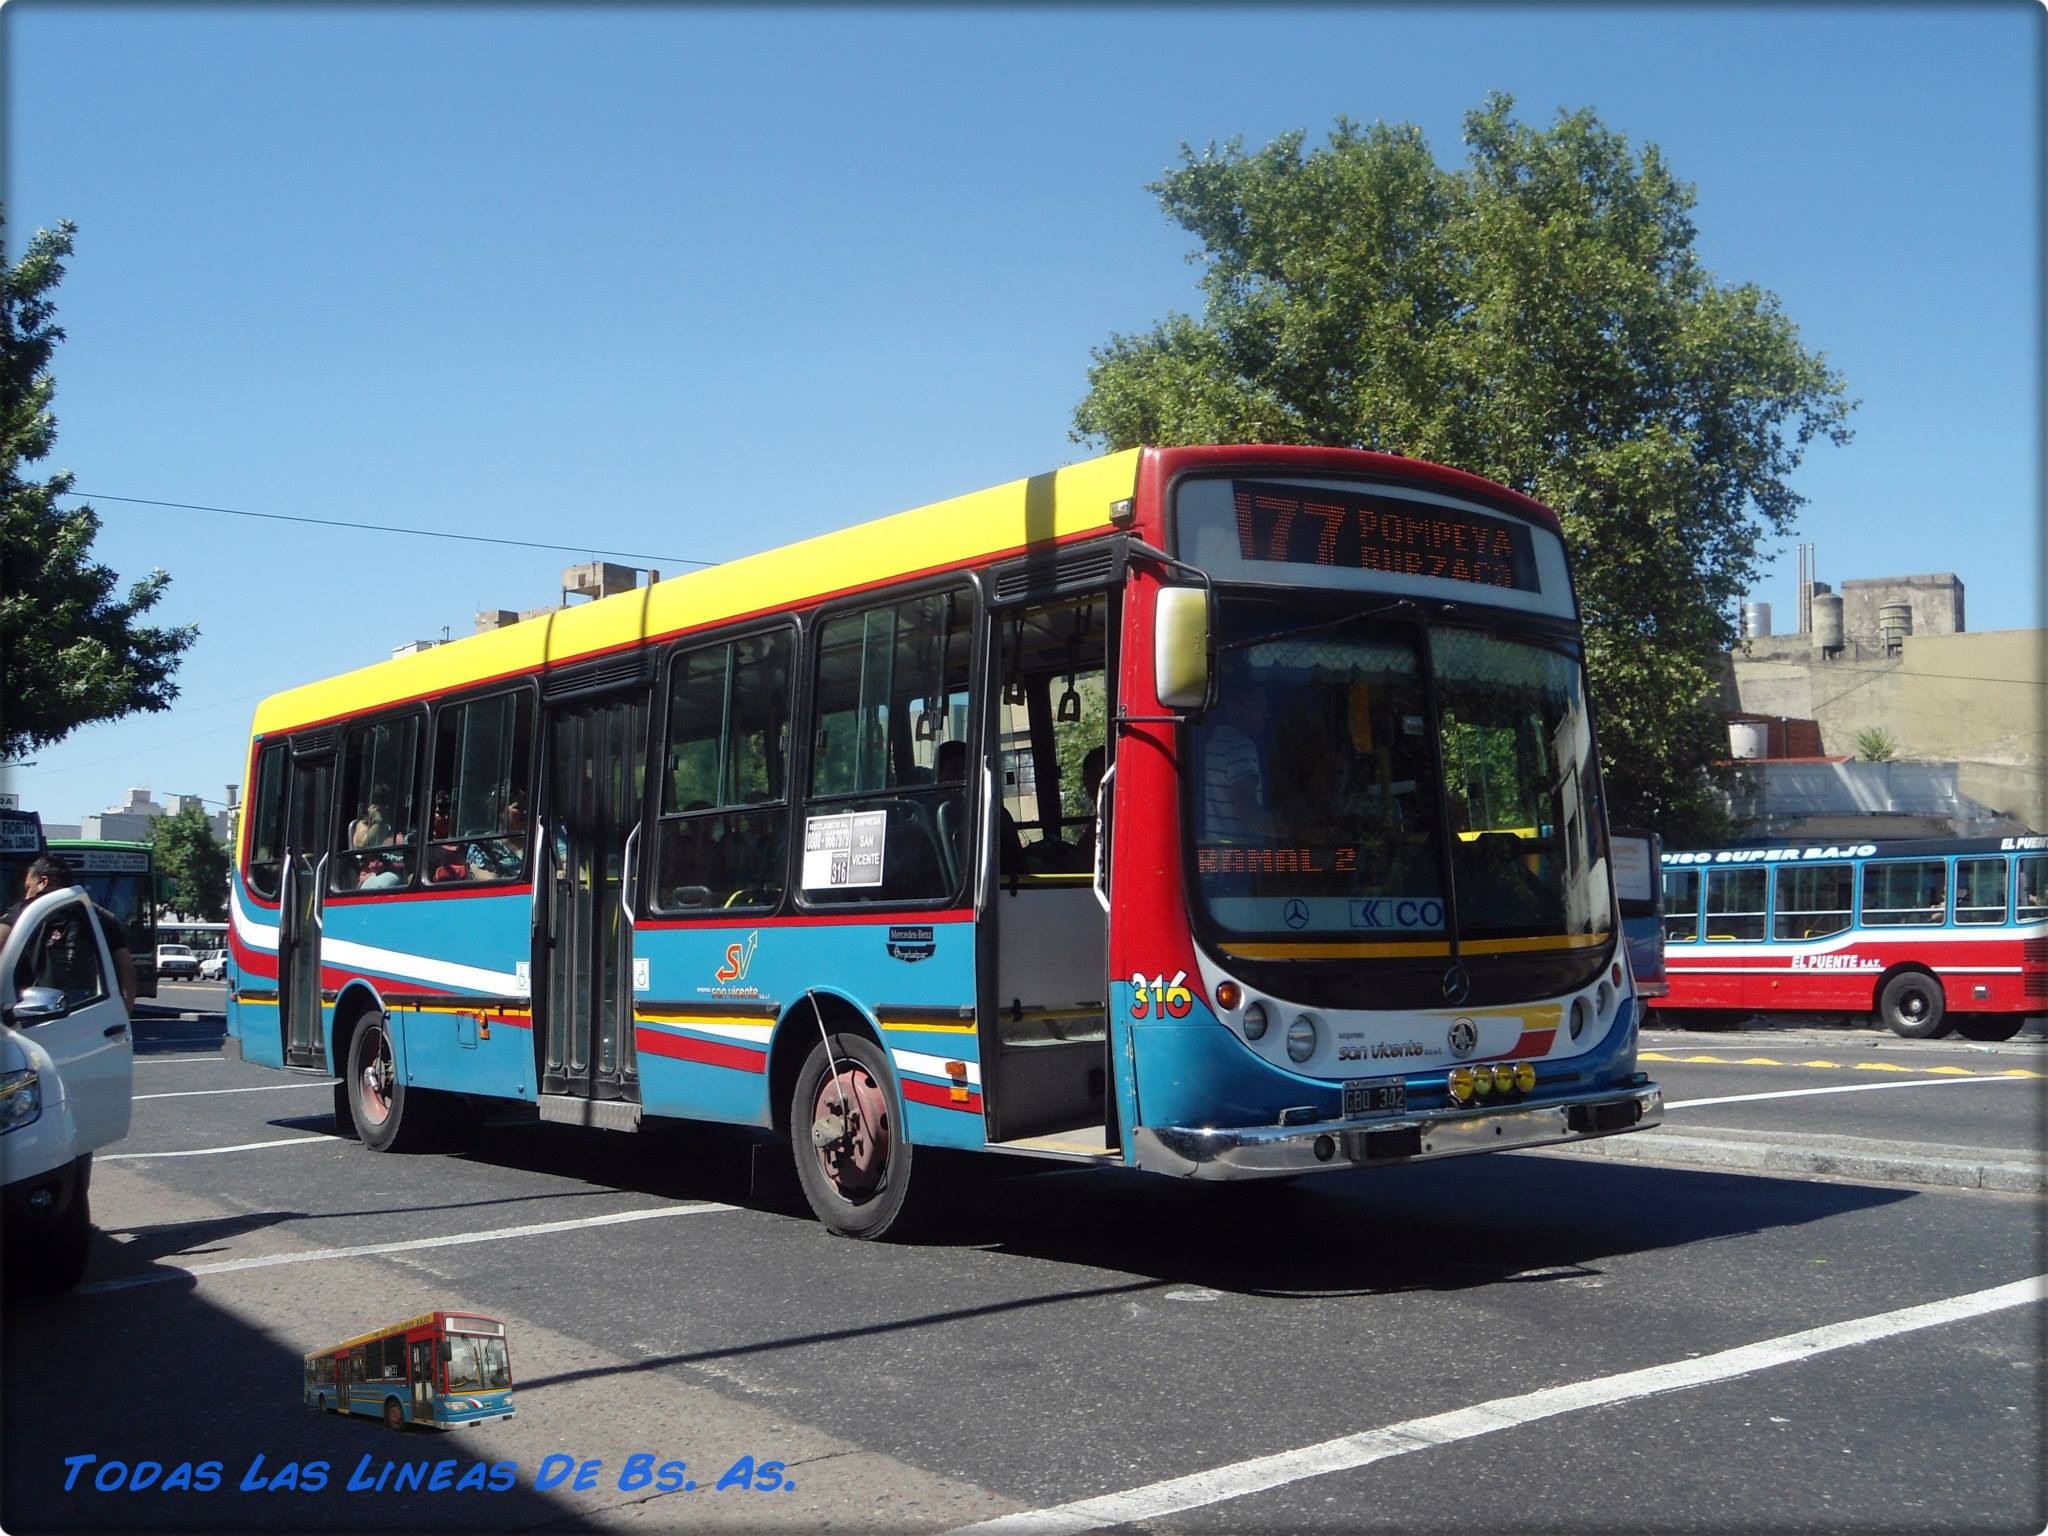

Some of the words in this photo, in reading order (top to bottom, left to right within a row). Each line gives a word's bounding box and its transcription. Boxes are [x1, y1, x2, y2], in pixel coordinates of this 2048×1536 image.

[1236, 492, 1346, 567] 177
[1359, 509, 1512, 558] POMPEYA
[860, 834, 874, 848] SAN
[2001, 837, 2015, 850] EL
[2016, 837, 2048, 849] PUEN
[852, 852, 880, 866] VICENTE
[1198, 847, 1324, 873] RAMAL
[1336, 847, 1358, 872] 2
[1716, 849, 1799, 863] SUPER
[1803, 845, 1877, 859] BAJO
[832, 862, 846, 884] 316
[1792, 955, 1807, 968] EL
[1808, 954, 1859, 968] PUENTE
[1130, 970, 1193, 1019] 316
[1338, 1045, 1368, 1061] san
[1371, 1040, 1424, 1060] vicente
[1379, 1087, 1404, 1108] 342
